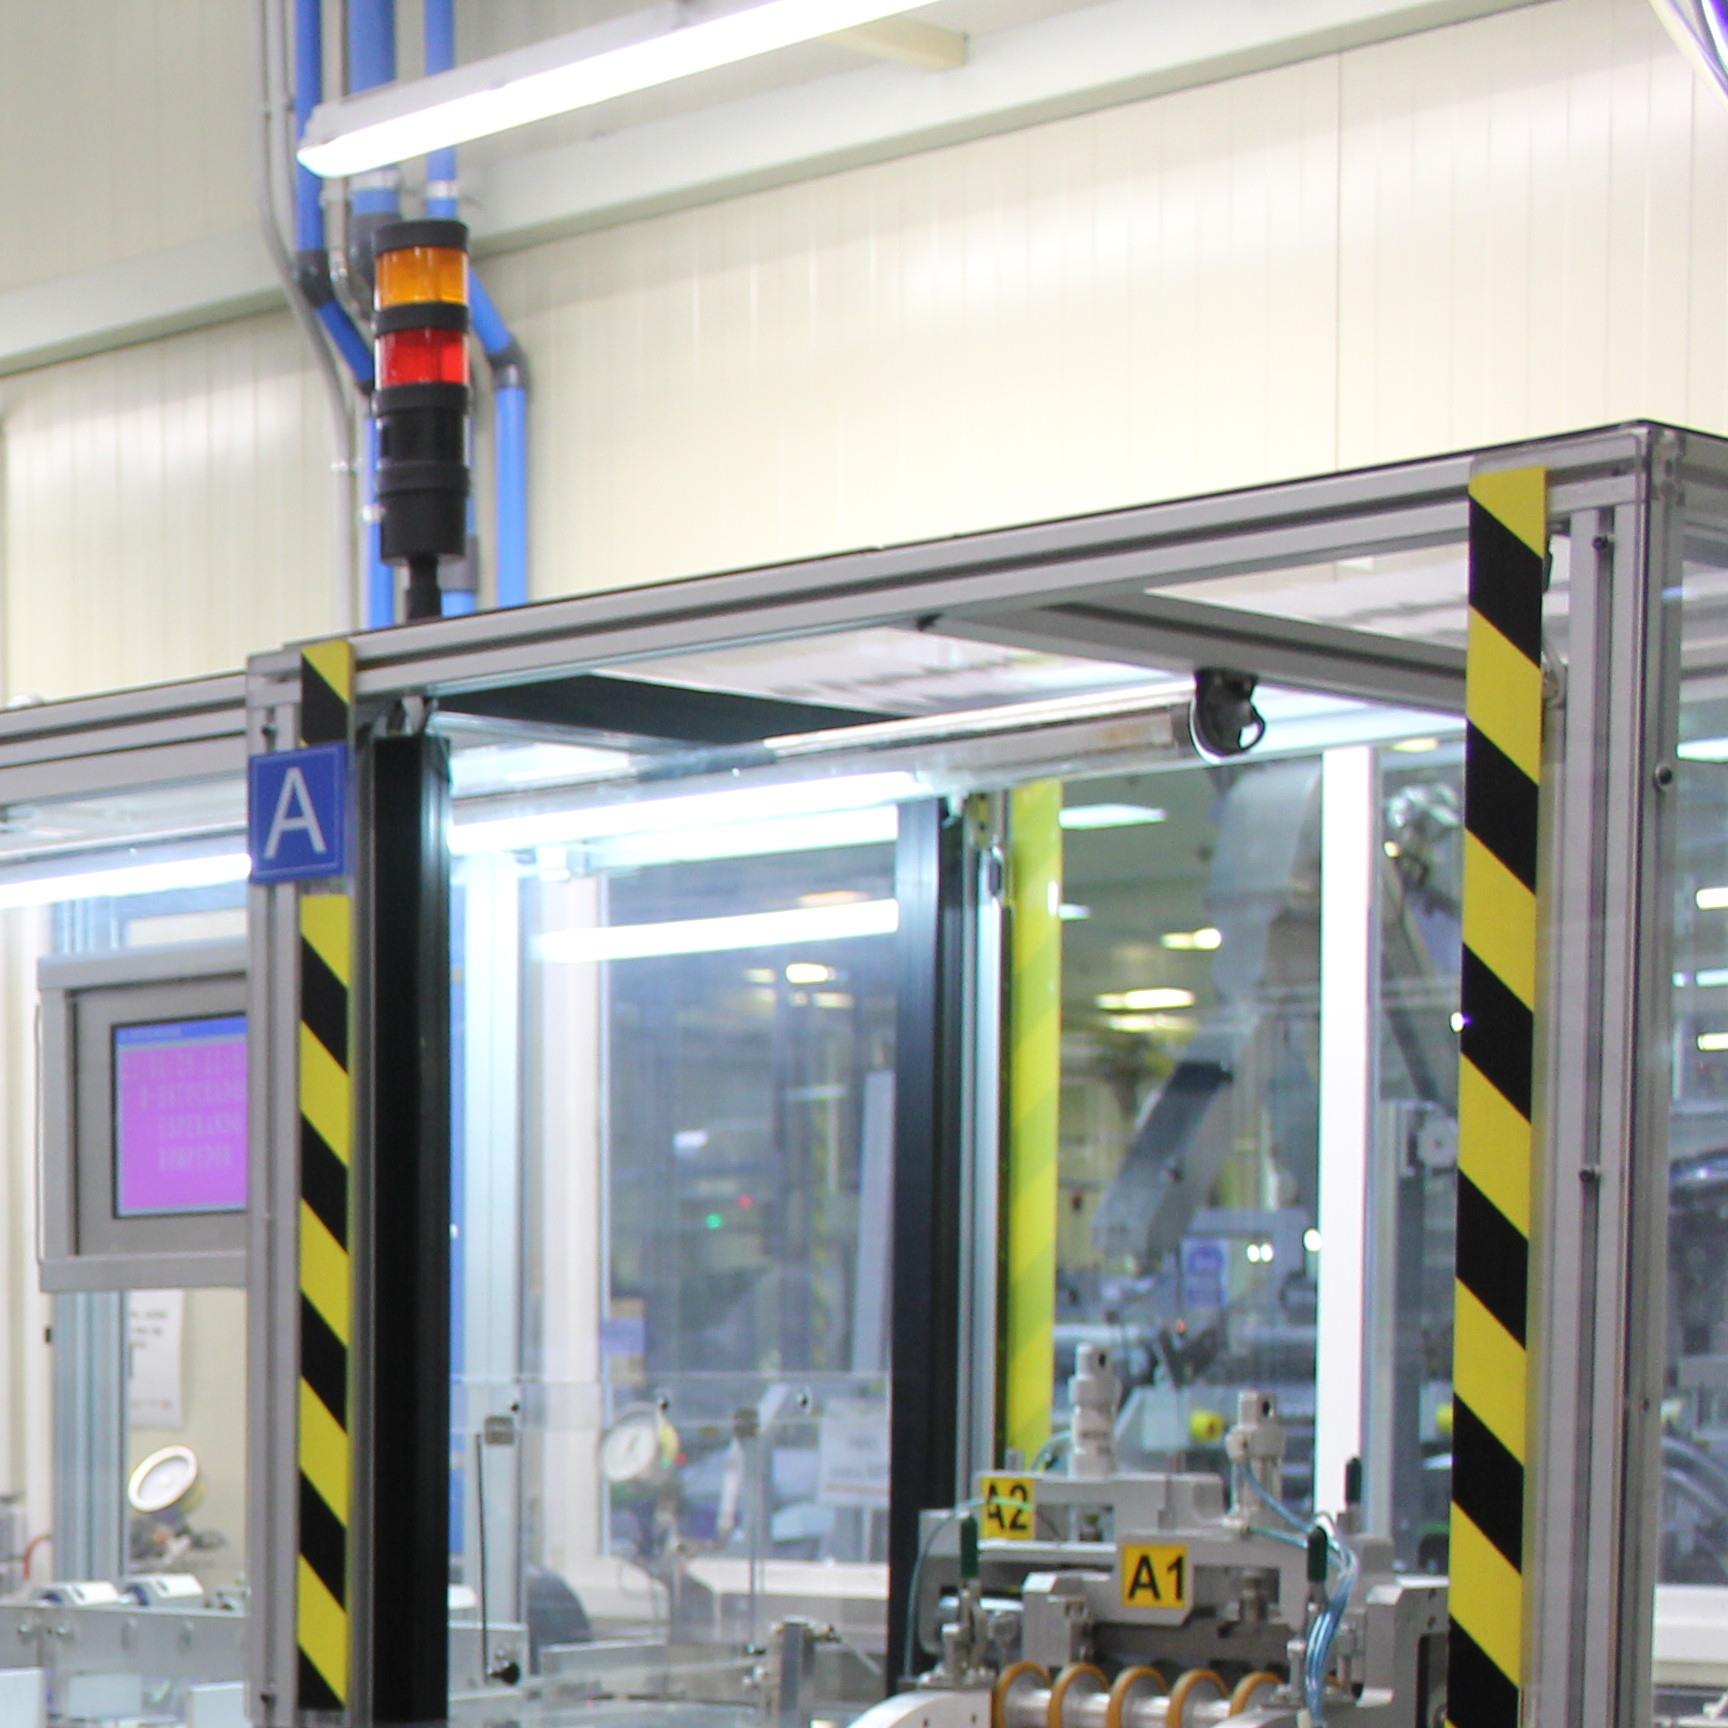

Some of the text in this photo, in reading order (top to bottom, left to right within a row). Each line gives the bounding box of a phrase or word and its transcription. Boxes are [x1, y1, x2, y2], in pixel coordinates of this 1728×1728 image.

[263, 766, 327, 860] A
[986, 1484, 1028, 1531] A2
[1127, 1554, 1184, 1602] A1
